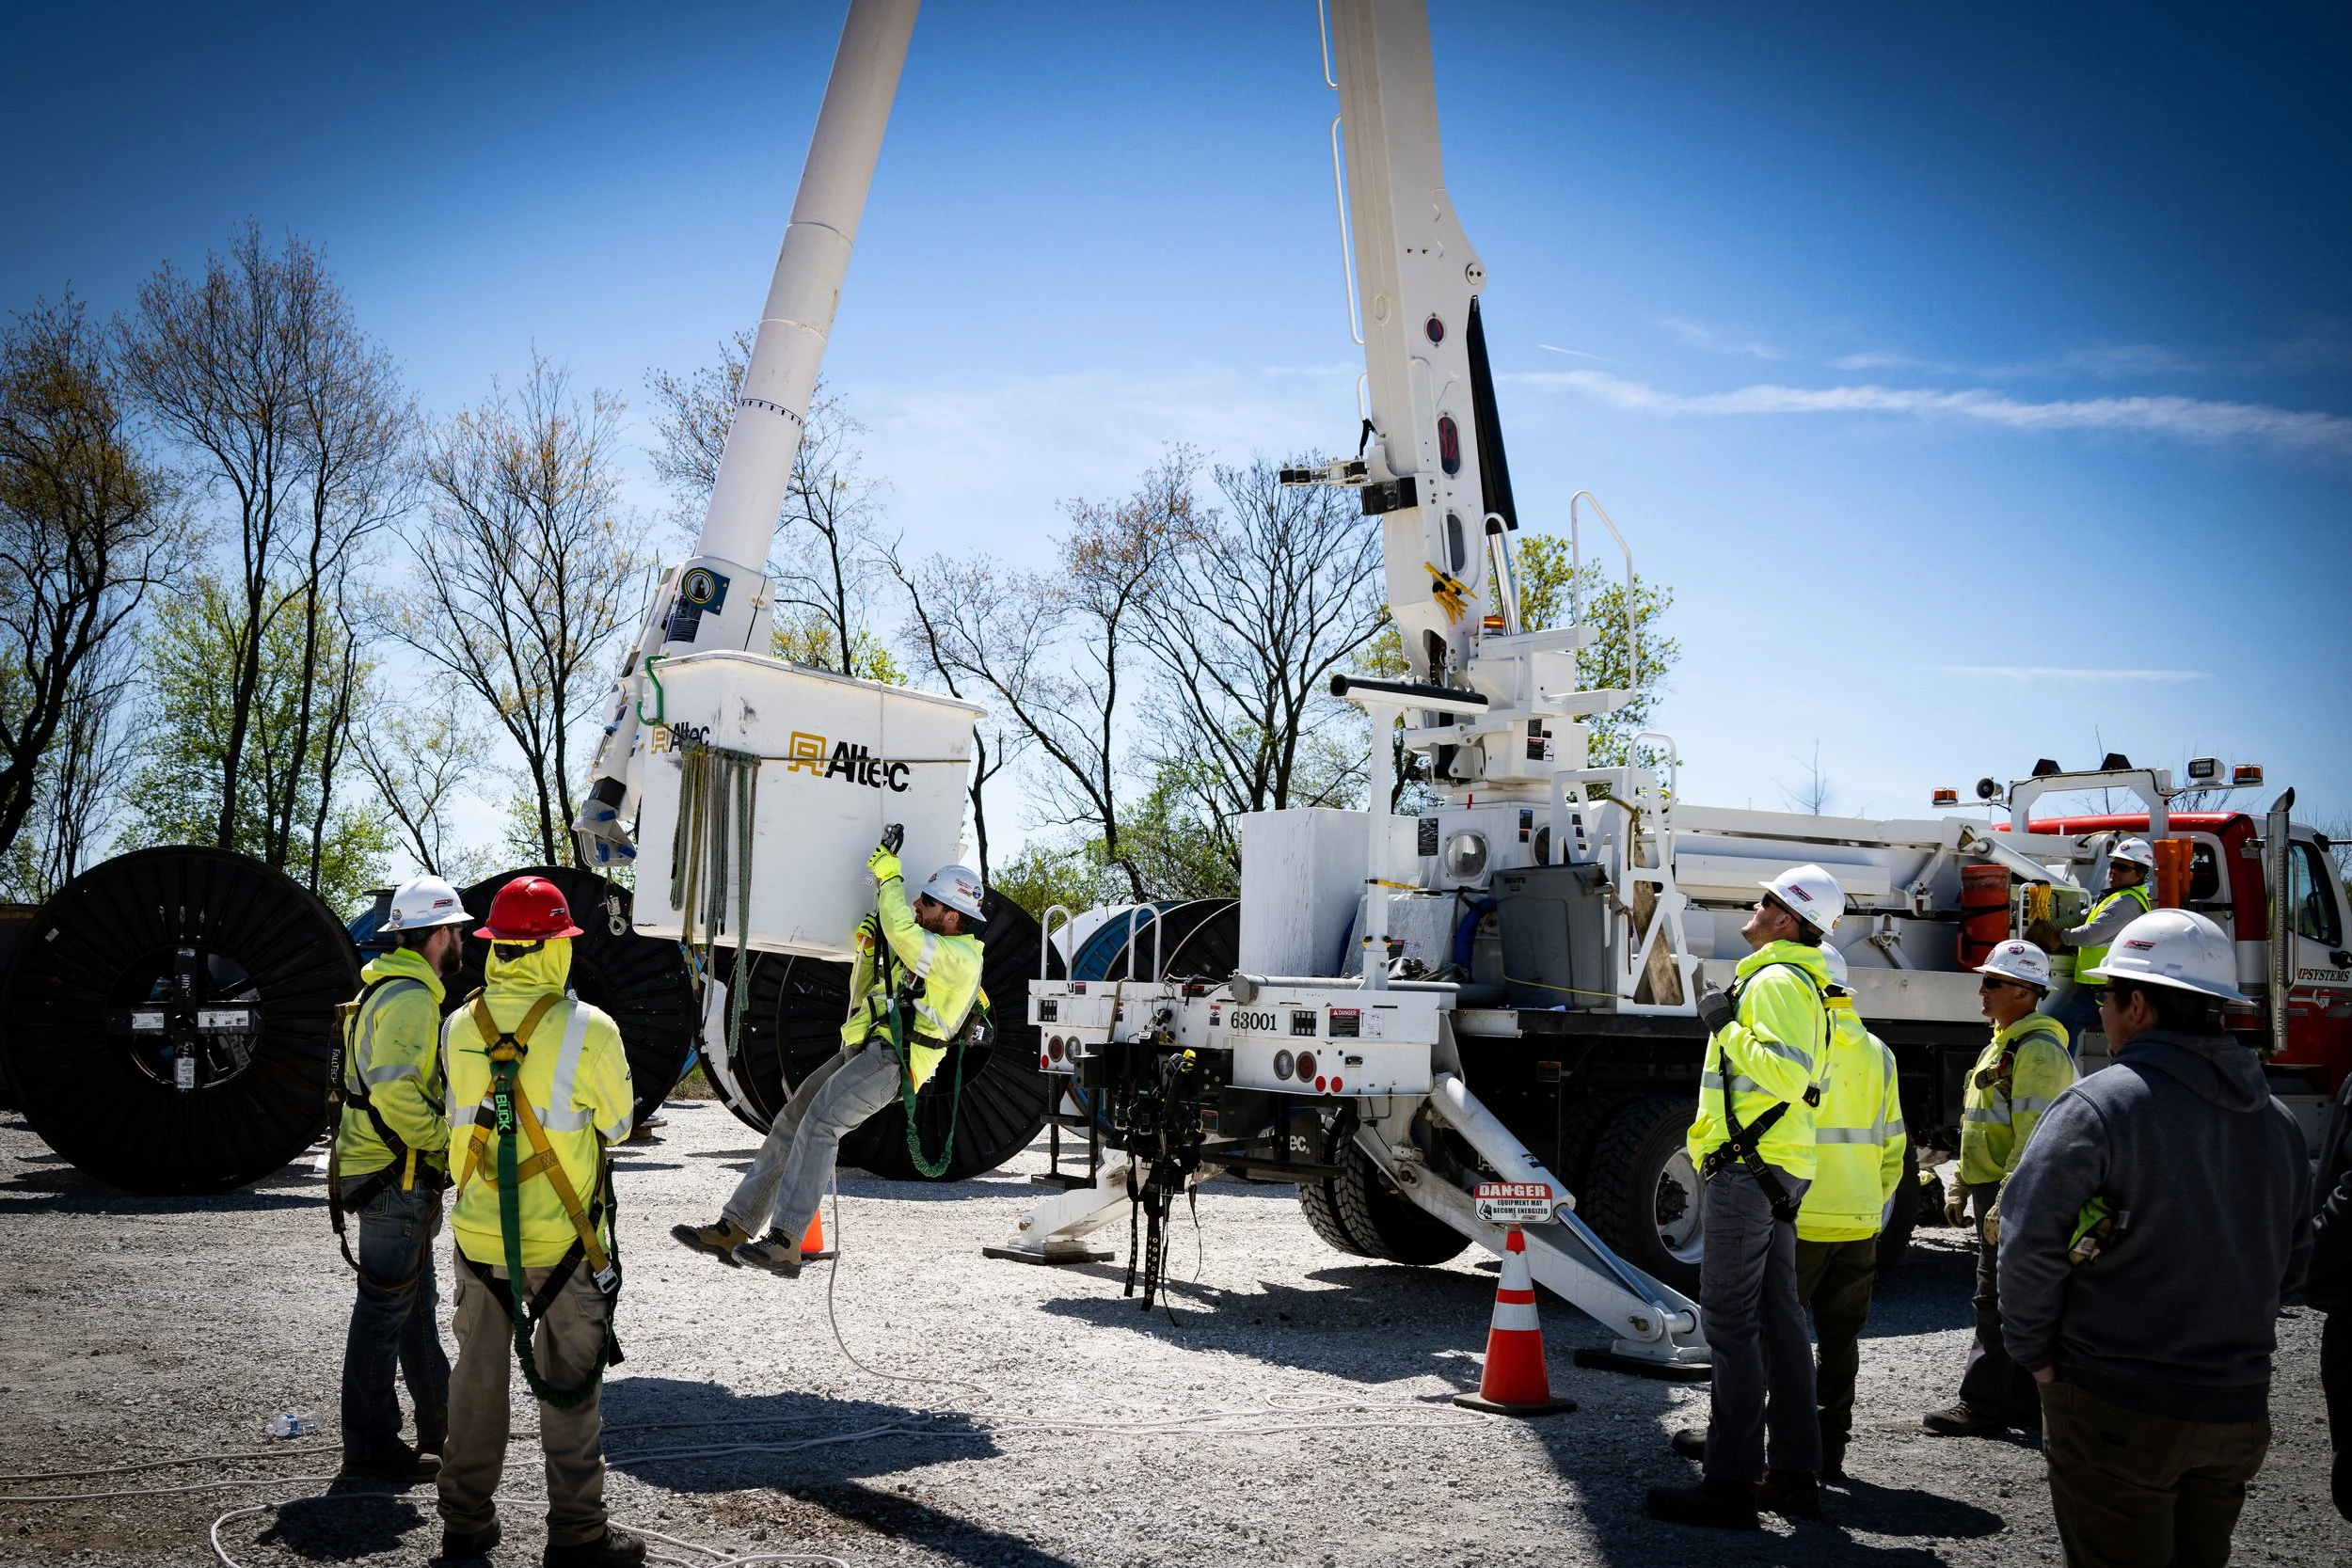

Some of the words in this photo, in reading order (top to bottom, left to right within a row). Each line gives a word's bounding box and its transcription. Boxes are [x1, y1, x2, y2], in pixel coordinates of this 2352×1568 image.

[824, 741, 911, 792] Altec
[1231, 1011, 1277, 1031] 63001
[496, 1094, 511, 1131] BUCK
[1479, 1184, 1546, 1196] DANGER
